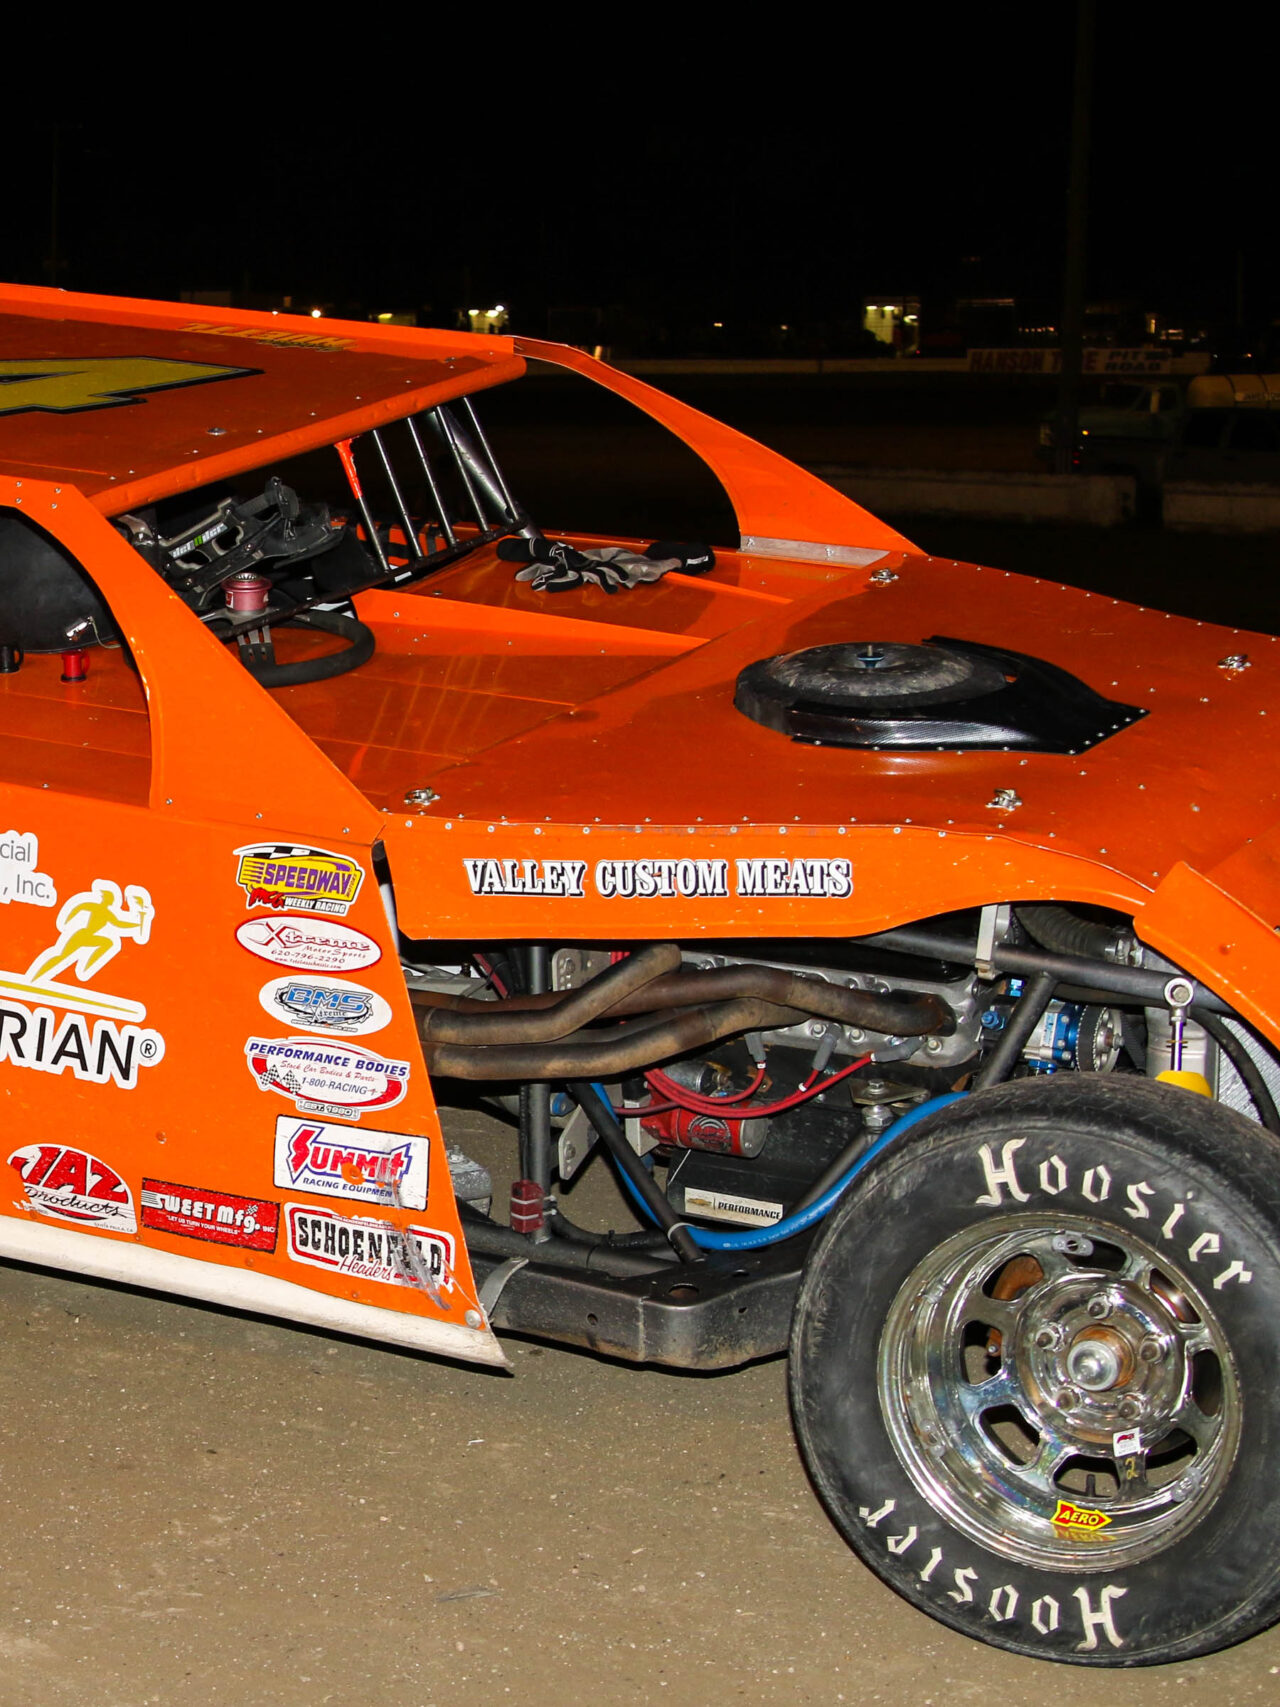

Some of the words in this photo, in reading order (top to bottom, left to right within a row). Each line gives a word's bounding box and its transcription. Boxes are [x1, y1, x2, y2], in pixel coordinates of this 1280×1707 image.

[1051, 351, 1097, 371] TE
[16, 873, 51, 899] Inc.
[262, 862, 353, 896] SPEEDWAY
[462, 858, 586, 897] VALLEY
[594, 858, 730, 898] CUSTOM
[734, 857, 853, 899] MEATS
[284, 895, 316, 909] WEEKLY
[314, 900, 347, 914] RACING
[286, 987, 366, 1013] BMS
[248, 1042, 351, 1067] PERFORMANCE
[355, 1059, 408, 1077] BODIES
[303, 1064, 318, 1074] Car
[10, 1146, 129, 1205] JAZ
[302, 1177, 339, 1190] RACING
[342, 1183, 399, 1198] EQUIPMEN
[151, 1191, 217, 1221] SWEET
[717, 1201, 782, 1220] PERFORMANCE
[975, 1137, 1252, 1290] Hoosier
[340, 1255, 393, 1281] Headers
[1058, 1509, 1100, 1526] AERO
[858, 1499, 1130, 1652] Hoosier
